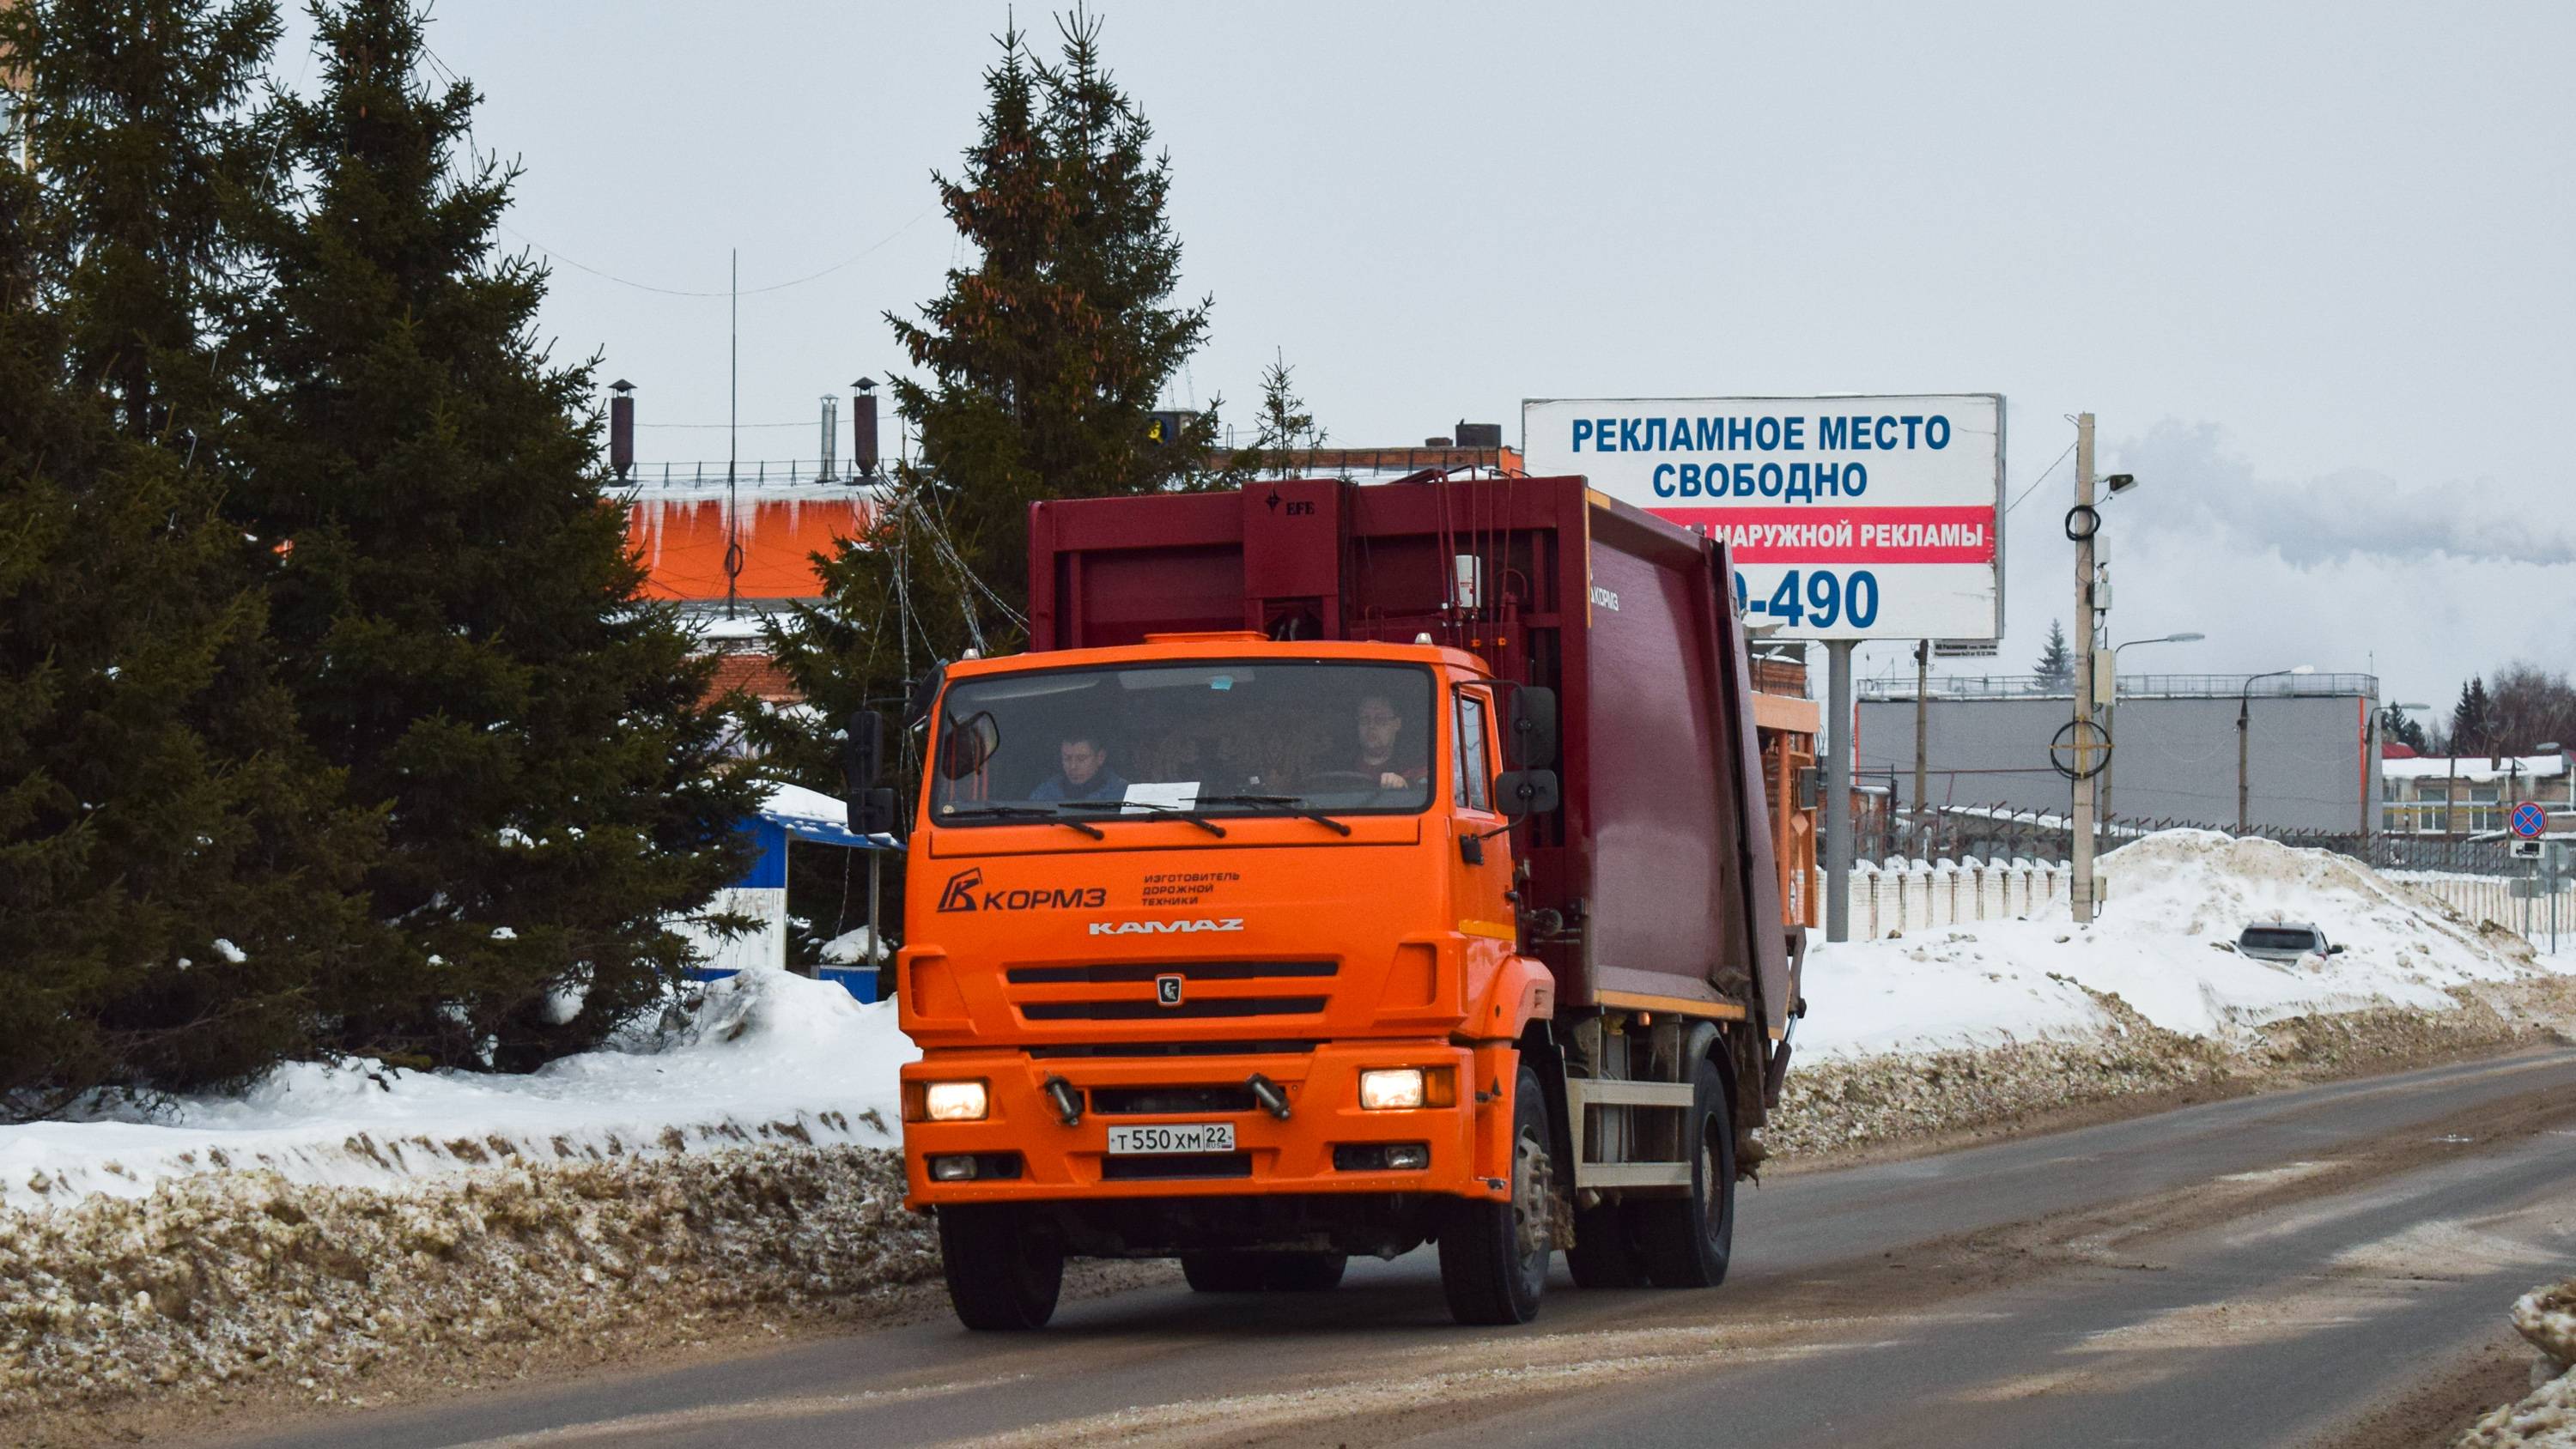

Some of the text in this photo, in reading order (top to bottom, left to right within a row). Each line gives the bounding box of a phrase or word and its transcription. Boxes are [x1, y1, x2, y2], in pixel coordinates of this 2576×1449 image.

[1572, 415, 1951, 452] РЕКЛАМНОЕ МЕСТО
[1653, 462, 1868, 504] СВОБОДНО
[1286, 500, 1315, 516] EFE
[1861, 524, 1983, 548] РЕКЛАМЫ
[1143, 872, 1241, 883] ИЗГОТОВИТЕЛЬ
[1142, 883, 1214, 895] ДОРОЖНОЙ
[982, 887, 1108, 912] КОРМЗ
[1141, 896, 1199, 906] ТЕХНИКИ
[1089, 918, 1244, 936] KAMAZ
